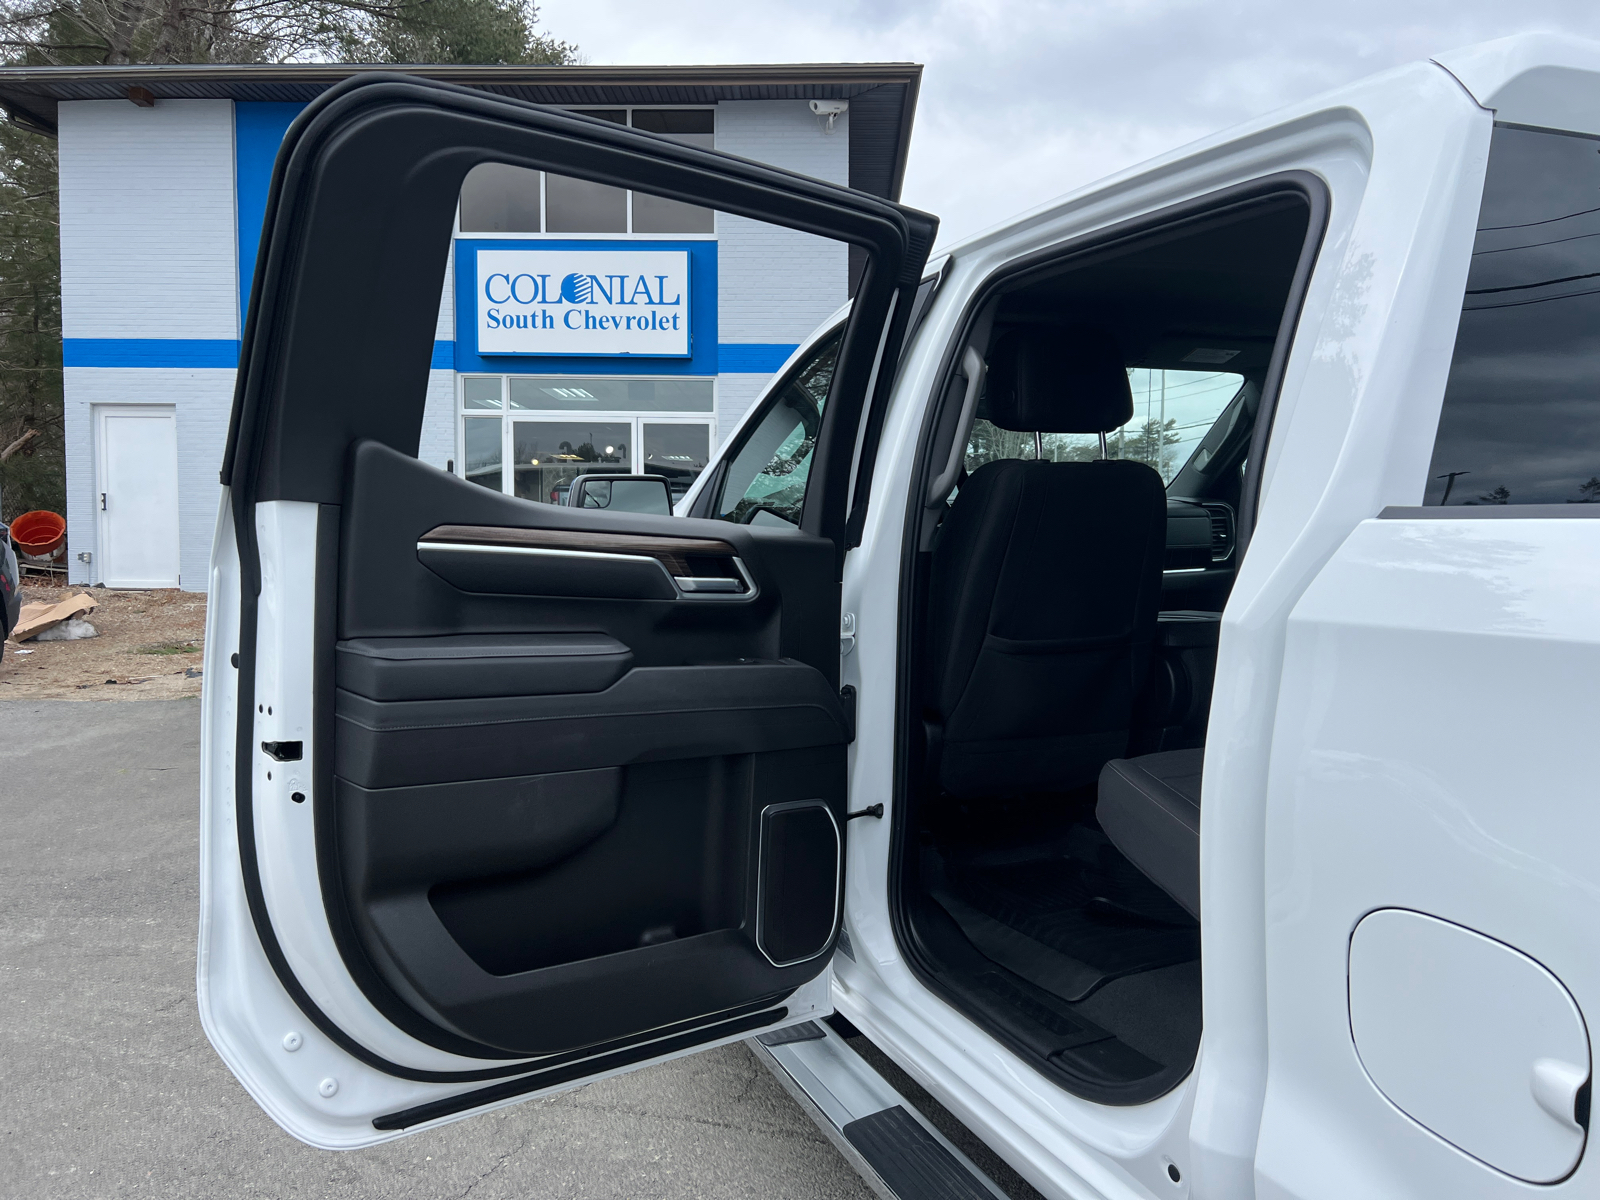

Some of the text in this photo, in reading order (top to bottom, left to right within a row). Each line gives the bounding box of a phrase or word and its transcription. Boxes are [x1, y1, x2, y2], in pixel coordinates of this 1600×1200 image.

[485, 273, 680, 305] COLONIAL
[487, 308, 680, 331] South Chevrolet
